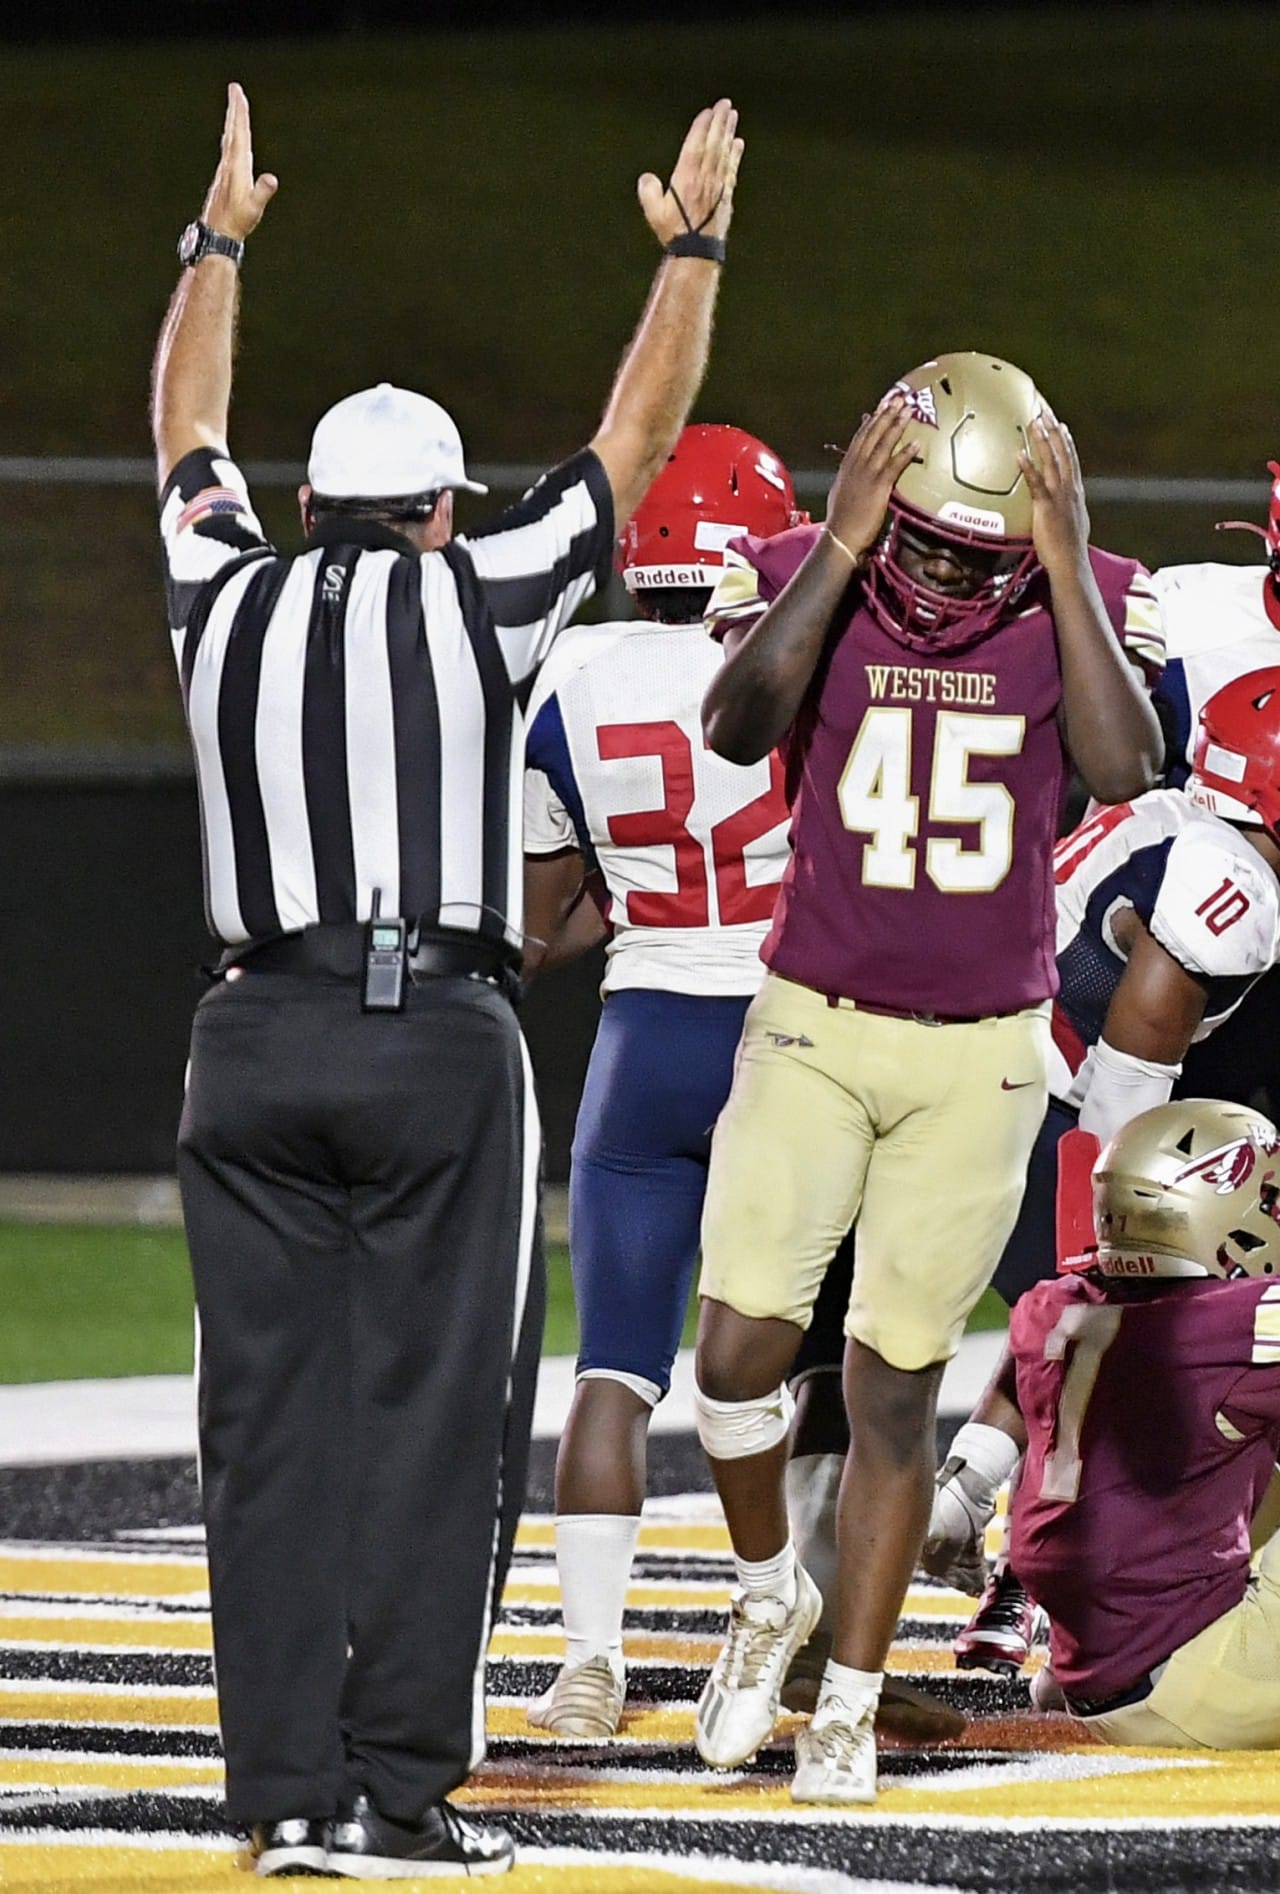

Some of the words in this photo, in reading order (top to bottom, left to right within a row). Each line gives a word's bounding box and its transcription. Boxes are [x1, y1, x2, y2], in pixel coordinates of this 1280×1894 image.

[634, 568, 706, 586] Riddell
[864, 664, 997, 705] WESTSIDE
[595, 720, 793, 928] 32
[836, 706, 1026, 893] 45
[1195, 877, 1250, 937] 10
